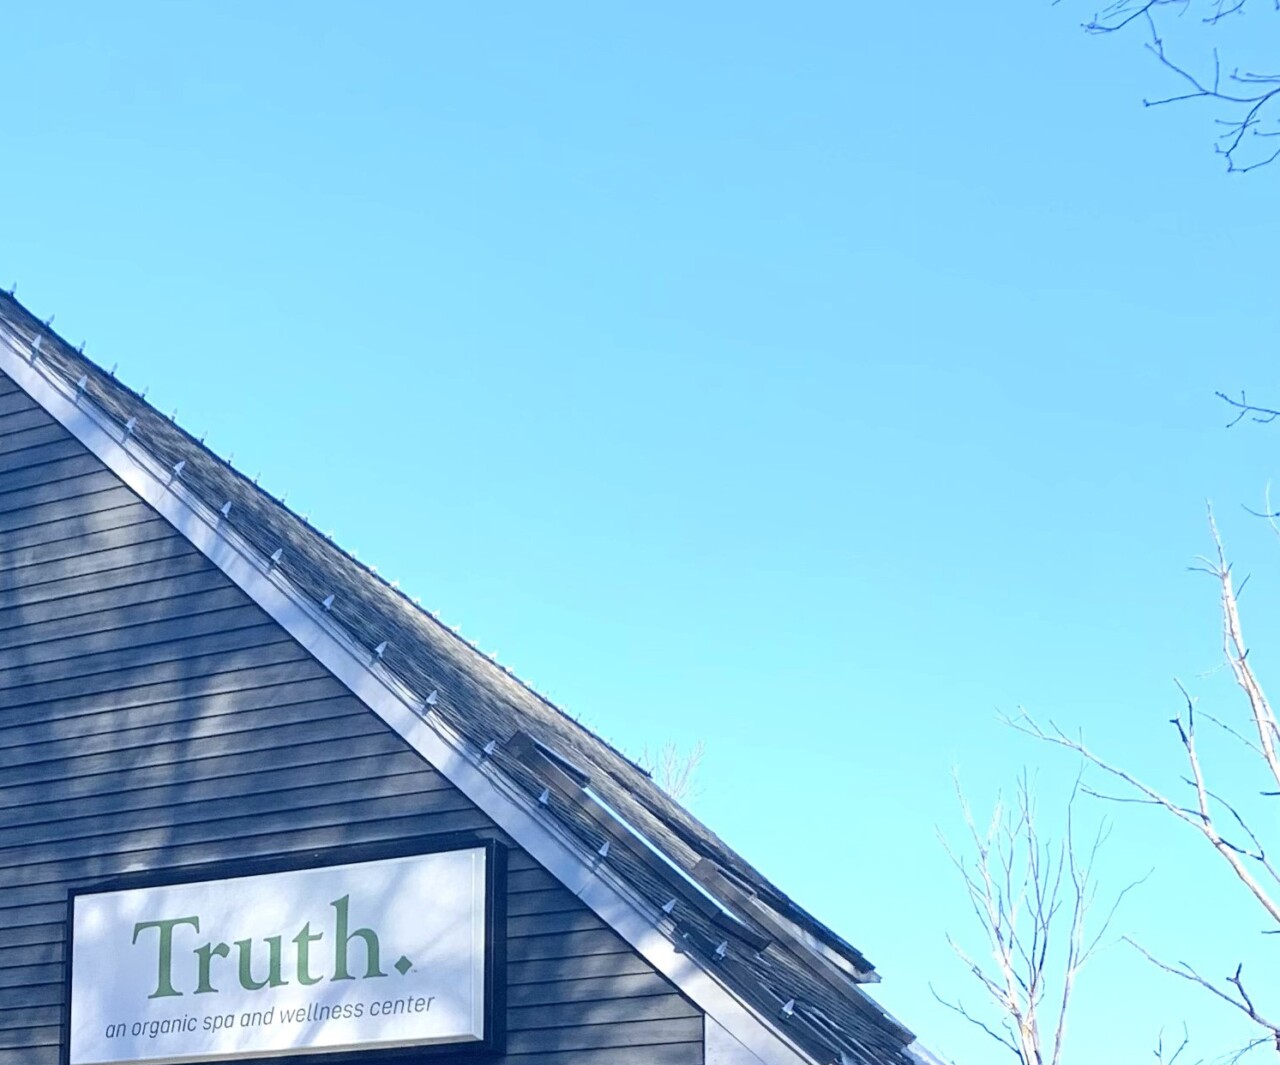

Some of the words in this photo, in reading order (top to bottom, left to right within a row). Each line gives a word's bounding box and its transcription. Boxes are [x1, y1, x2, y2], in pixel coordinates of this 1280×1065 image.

[132, 894, 414, 999] Truth.
[105, 1022, 126, 1039] an
[131, 1013, 197, 1039] organic
[202, 1012, 234, 1033] spa
[240, 1006, 274, 1028] and
[279, 999, 363, 1024] wellness
[369, 994, 435, 1015] center
